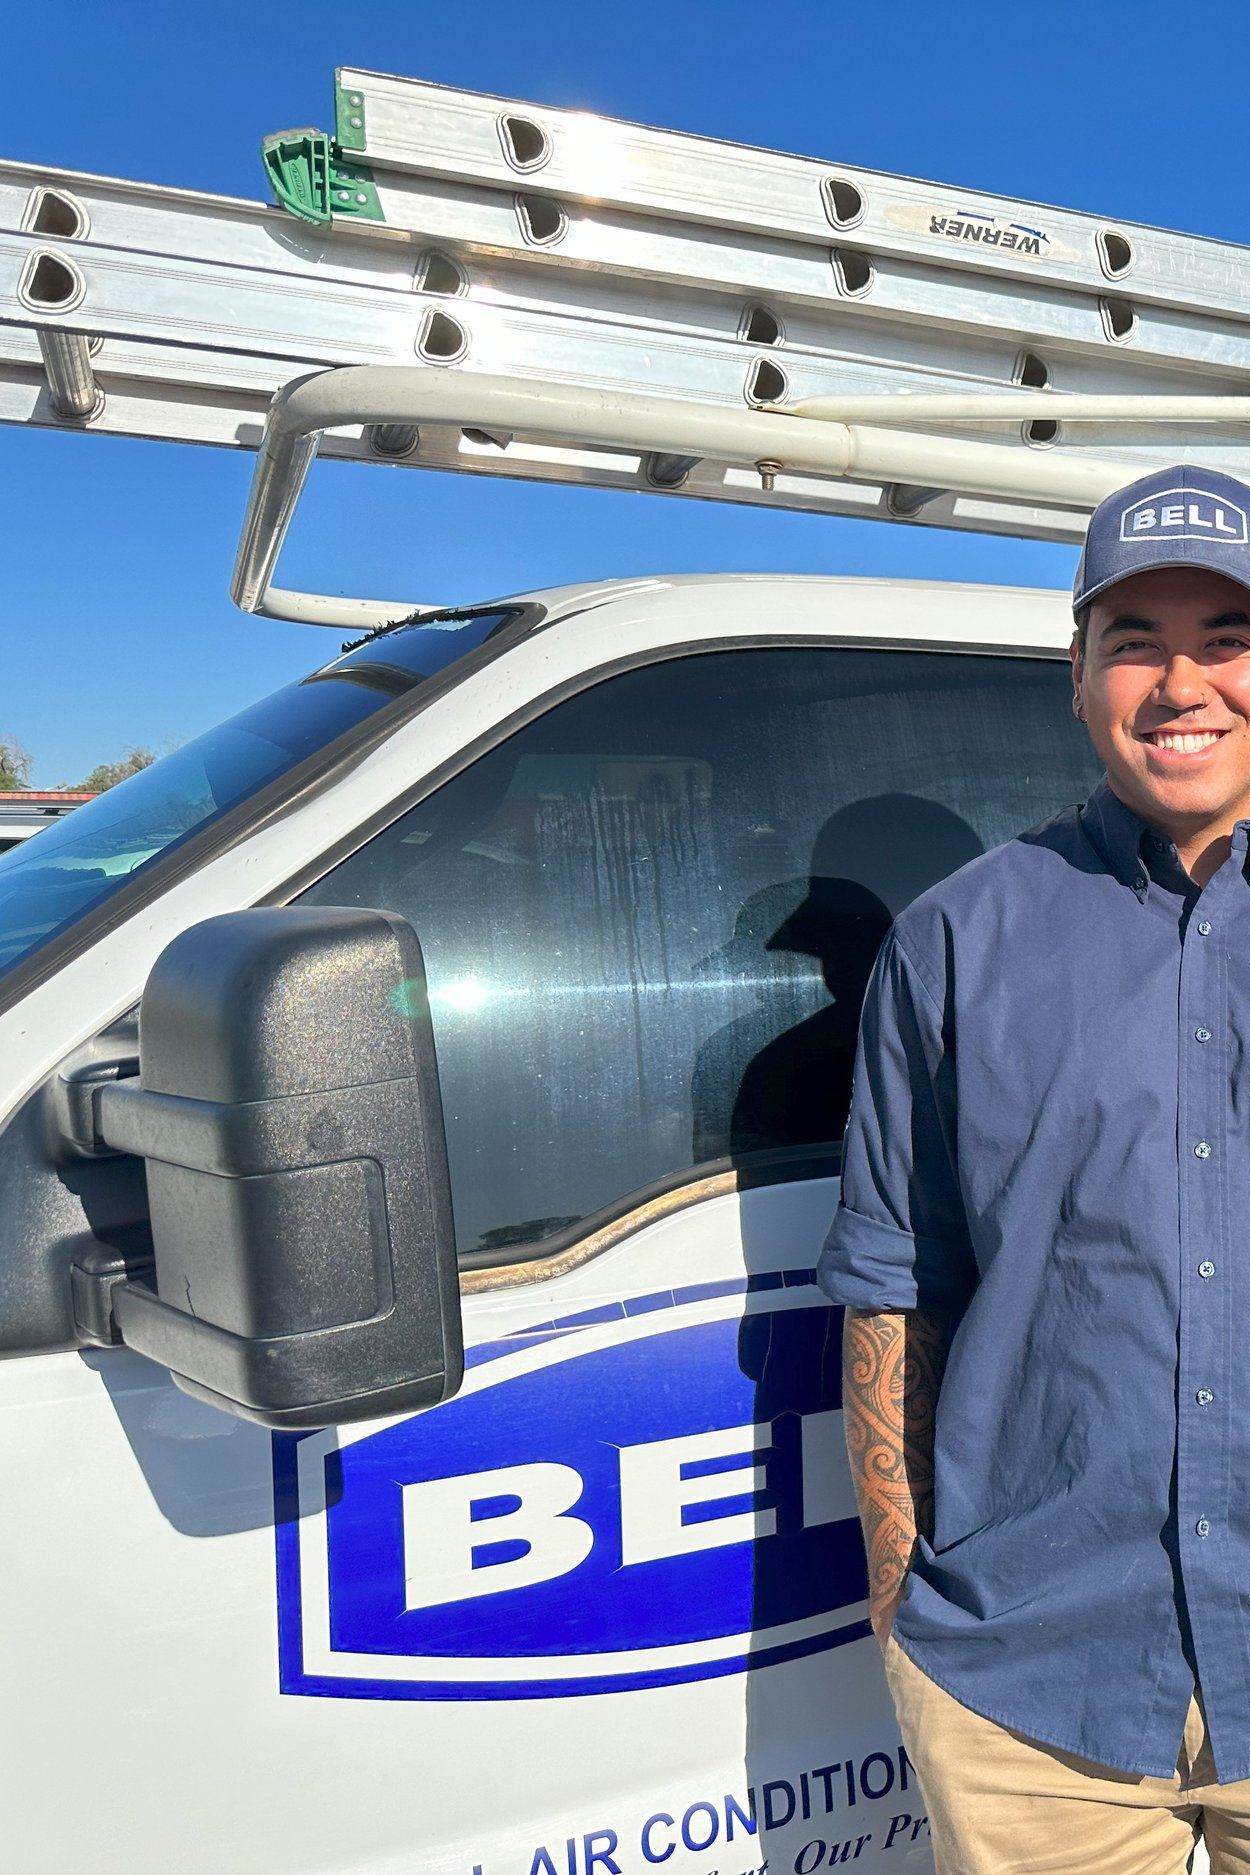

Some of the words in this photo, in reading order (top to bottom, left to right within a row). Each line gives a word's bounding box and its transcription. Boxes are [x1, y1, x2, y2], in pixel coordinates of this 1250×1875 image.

[929, 216, 1040, 255] WERNER
[1132, 504, 1237, 535] BELL
[529, 1828, 622, 1875] AIR
[794, 1833, 872, 1875] Our
